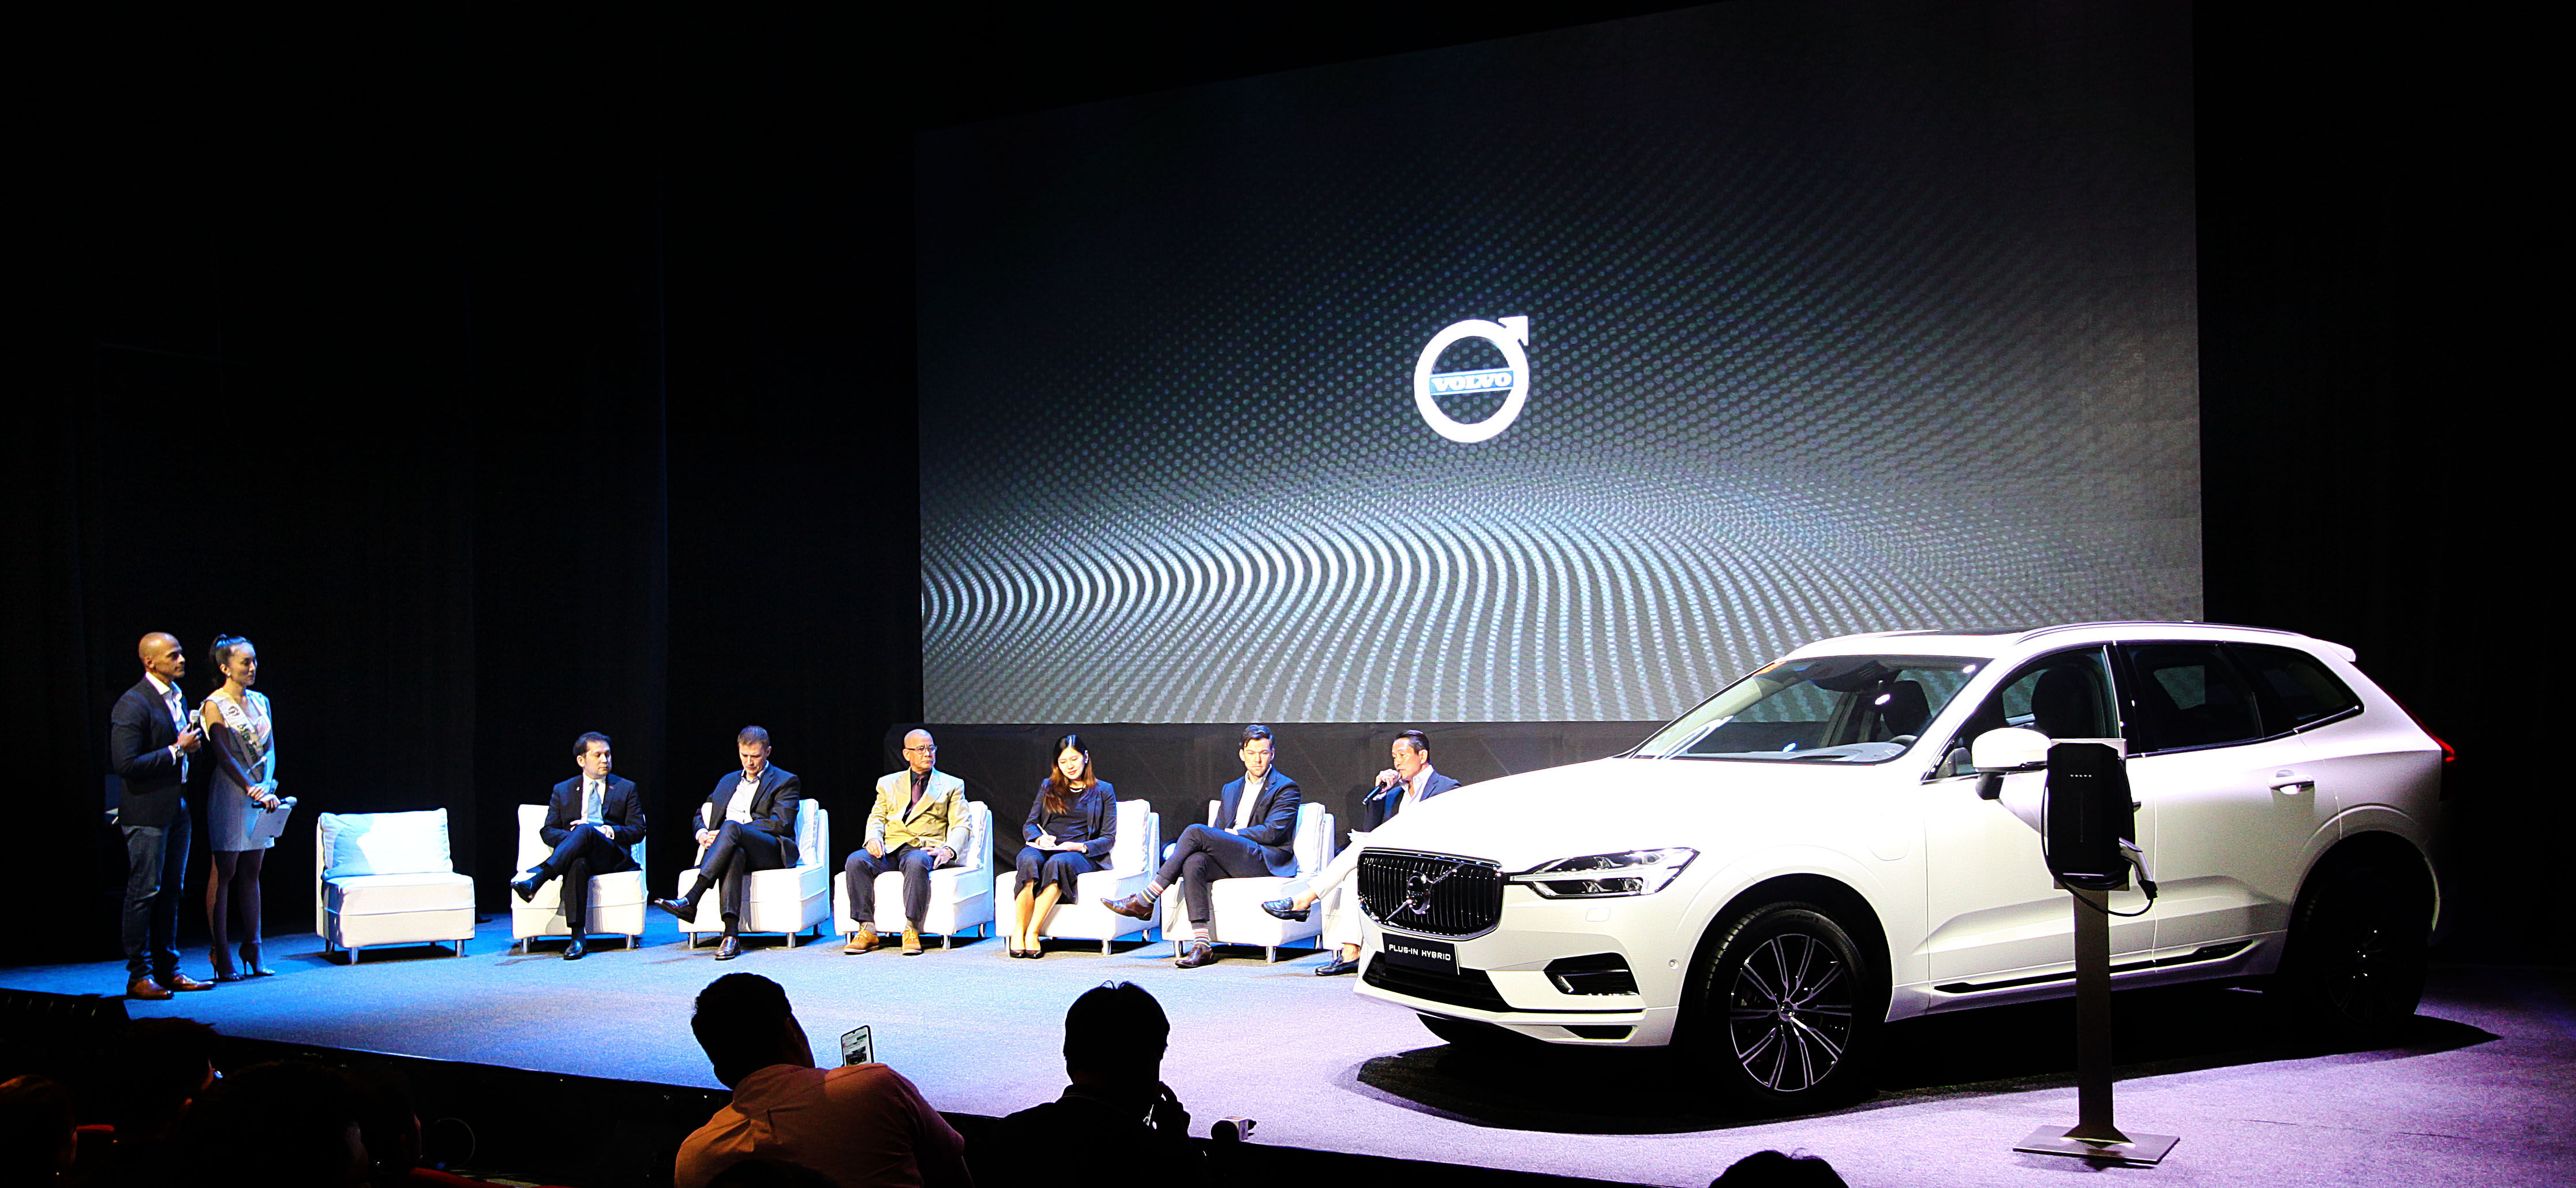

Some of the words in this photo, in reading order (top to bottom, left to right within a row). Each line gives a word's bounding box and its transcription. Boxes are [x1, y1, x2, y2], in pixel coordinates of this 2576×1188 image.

[1431, 372, 1512, 391] VOLVO
[1388, 944, 1418, 955] PLUG-IN
[1421, 950, 1451, 961] HYBRID
